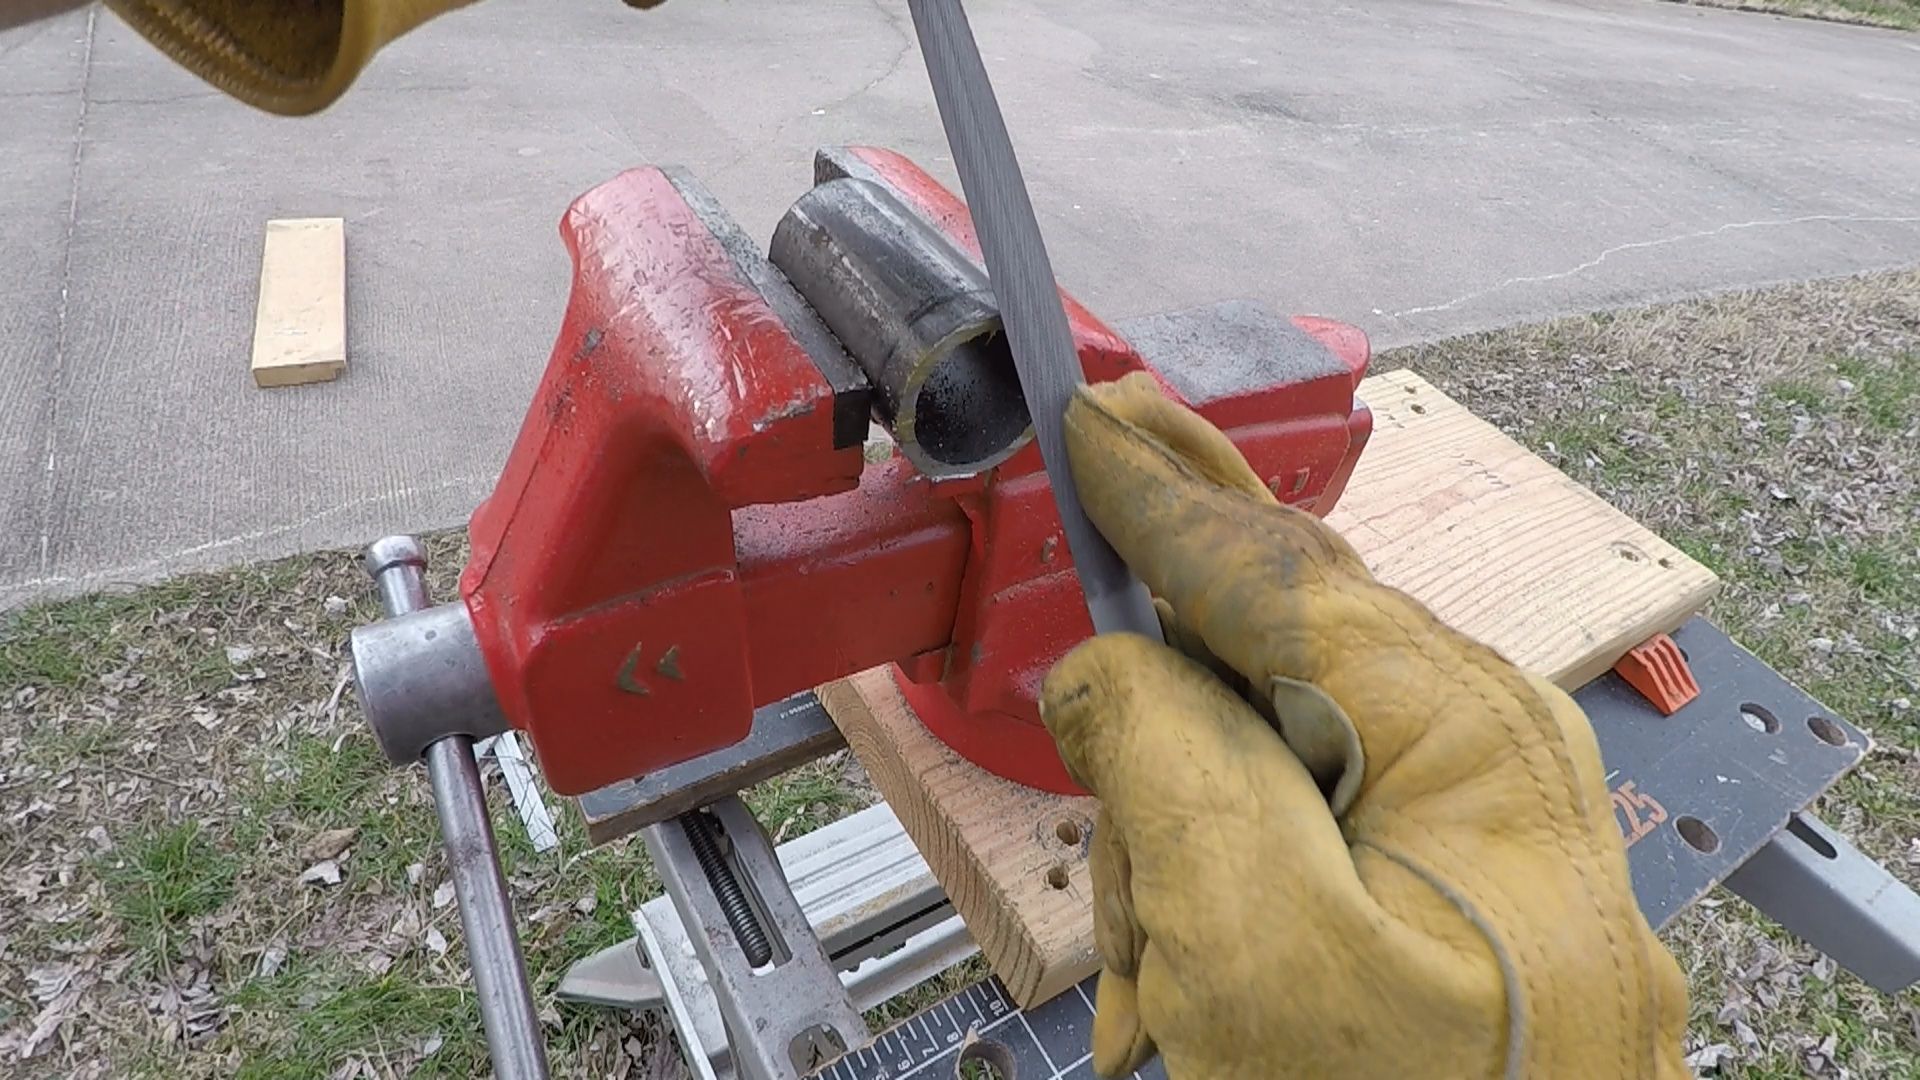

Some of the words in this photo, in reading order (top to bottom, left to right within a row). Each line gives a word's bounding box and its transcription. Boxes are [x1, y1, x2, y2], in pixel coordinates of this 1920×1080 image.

[1609, 780, 1669, 848] 25
[989, 1000, 1005, 1016] 10
[971, 1019, 983, 1029] 9
[946, 1031, 959, 1043] 8
[922, 1047, 935, 1058] 7
[897, 1059, 911, 1071] 6
